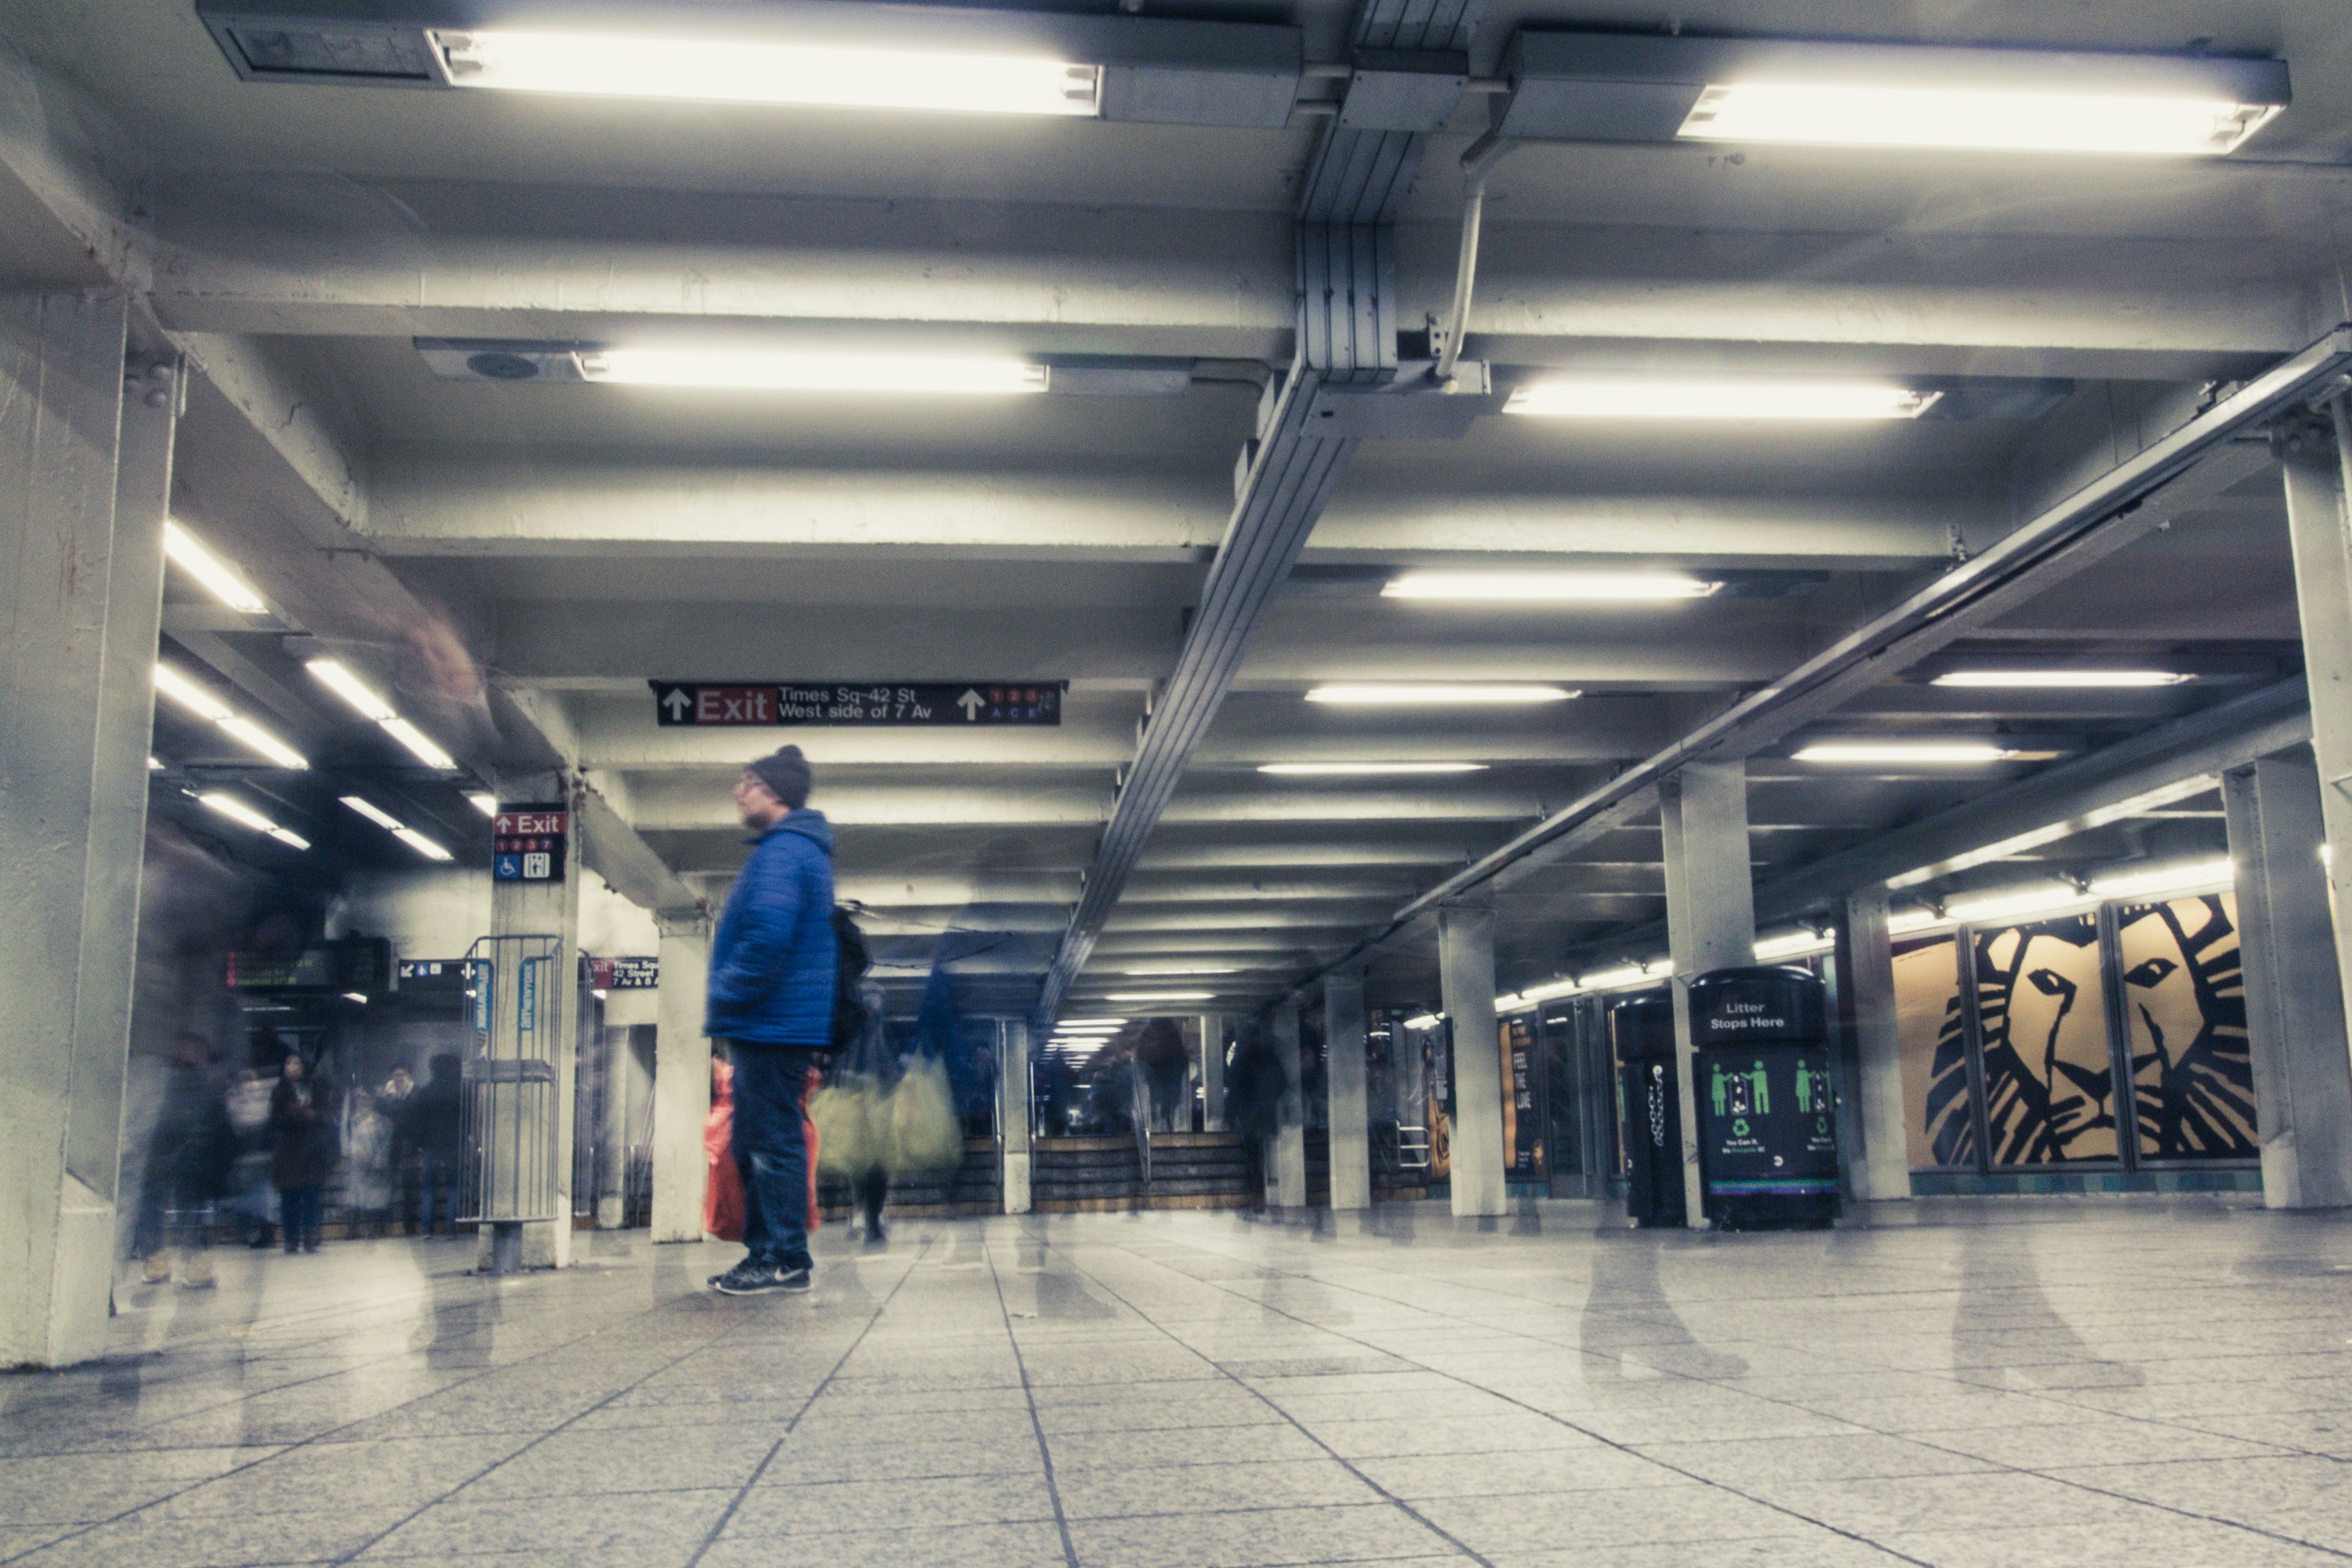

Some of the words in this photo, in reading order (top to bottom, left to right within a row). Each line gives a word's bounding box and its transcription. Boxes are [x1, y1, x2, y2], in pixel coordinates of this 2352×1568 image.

[779, 687, 829, 702] Times
[837, 688, 891, 705] Sq-42
[898, 688, 916, 703] St
[697, 690, 768, 720] Exit
[779, 703, 822, 718] West
[829, 703, 864, 718] side
[870, 704, 887, 718] of
[895, 705, 905, 718] 7
[912, 704, 931, 719] Av
[518, 815, 559, 833] Exit
[613, 969, 625, 978] 42
[628, 969, 654, 978] Street
[1726, 1004, 1765, 1014] Litter
[1711, 1019, 1748, 1030] Stops
[1751, 1017, 1785, 1028] Here
